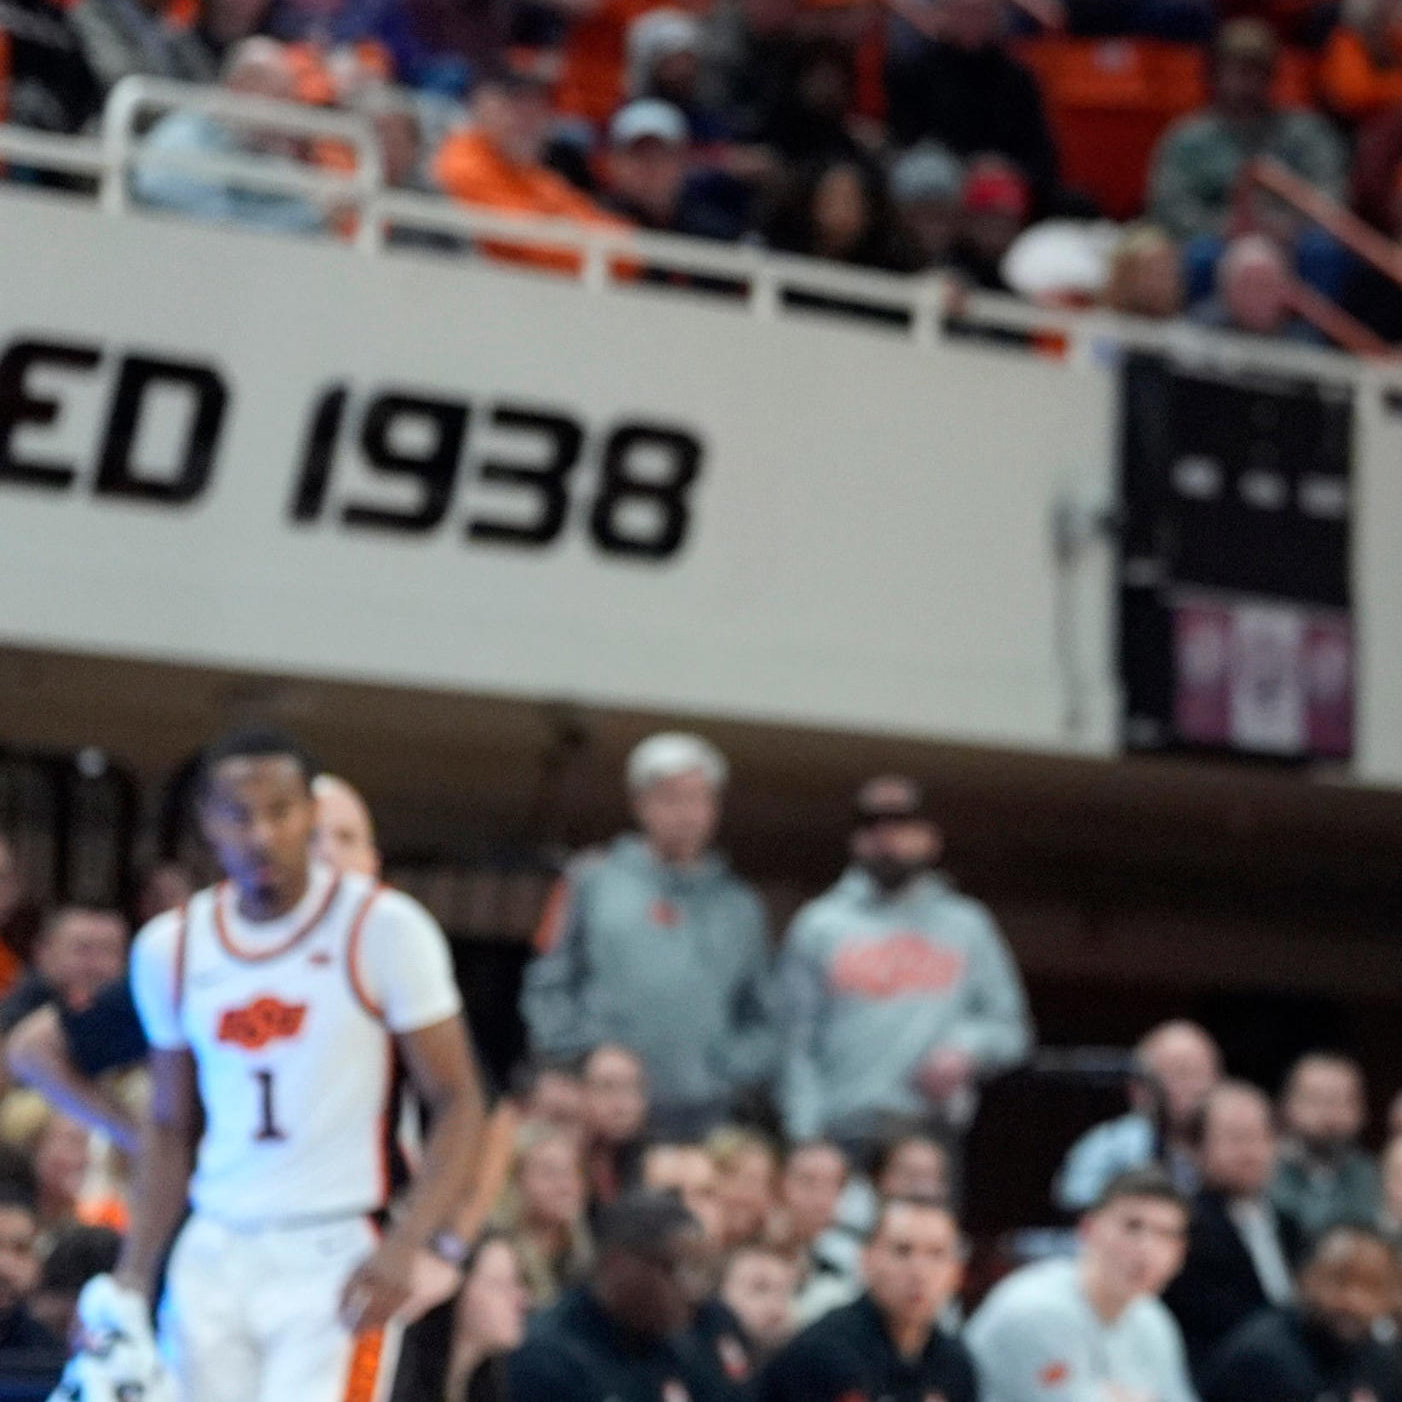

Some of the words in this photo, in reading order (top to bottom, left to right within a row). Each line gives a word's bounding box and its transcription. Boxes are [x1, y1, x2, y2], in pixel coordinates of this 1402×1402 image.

[0, 339, 230, 509] ED
[288, 382, 704, 562] 1938
[253, 1069, 289, 1141] 1
